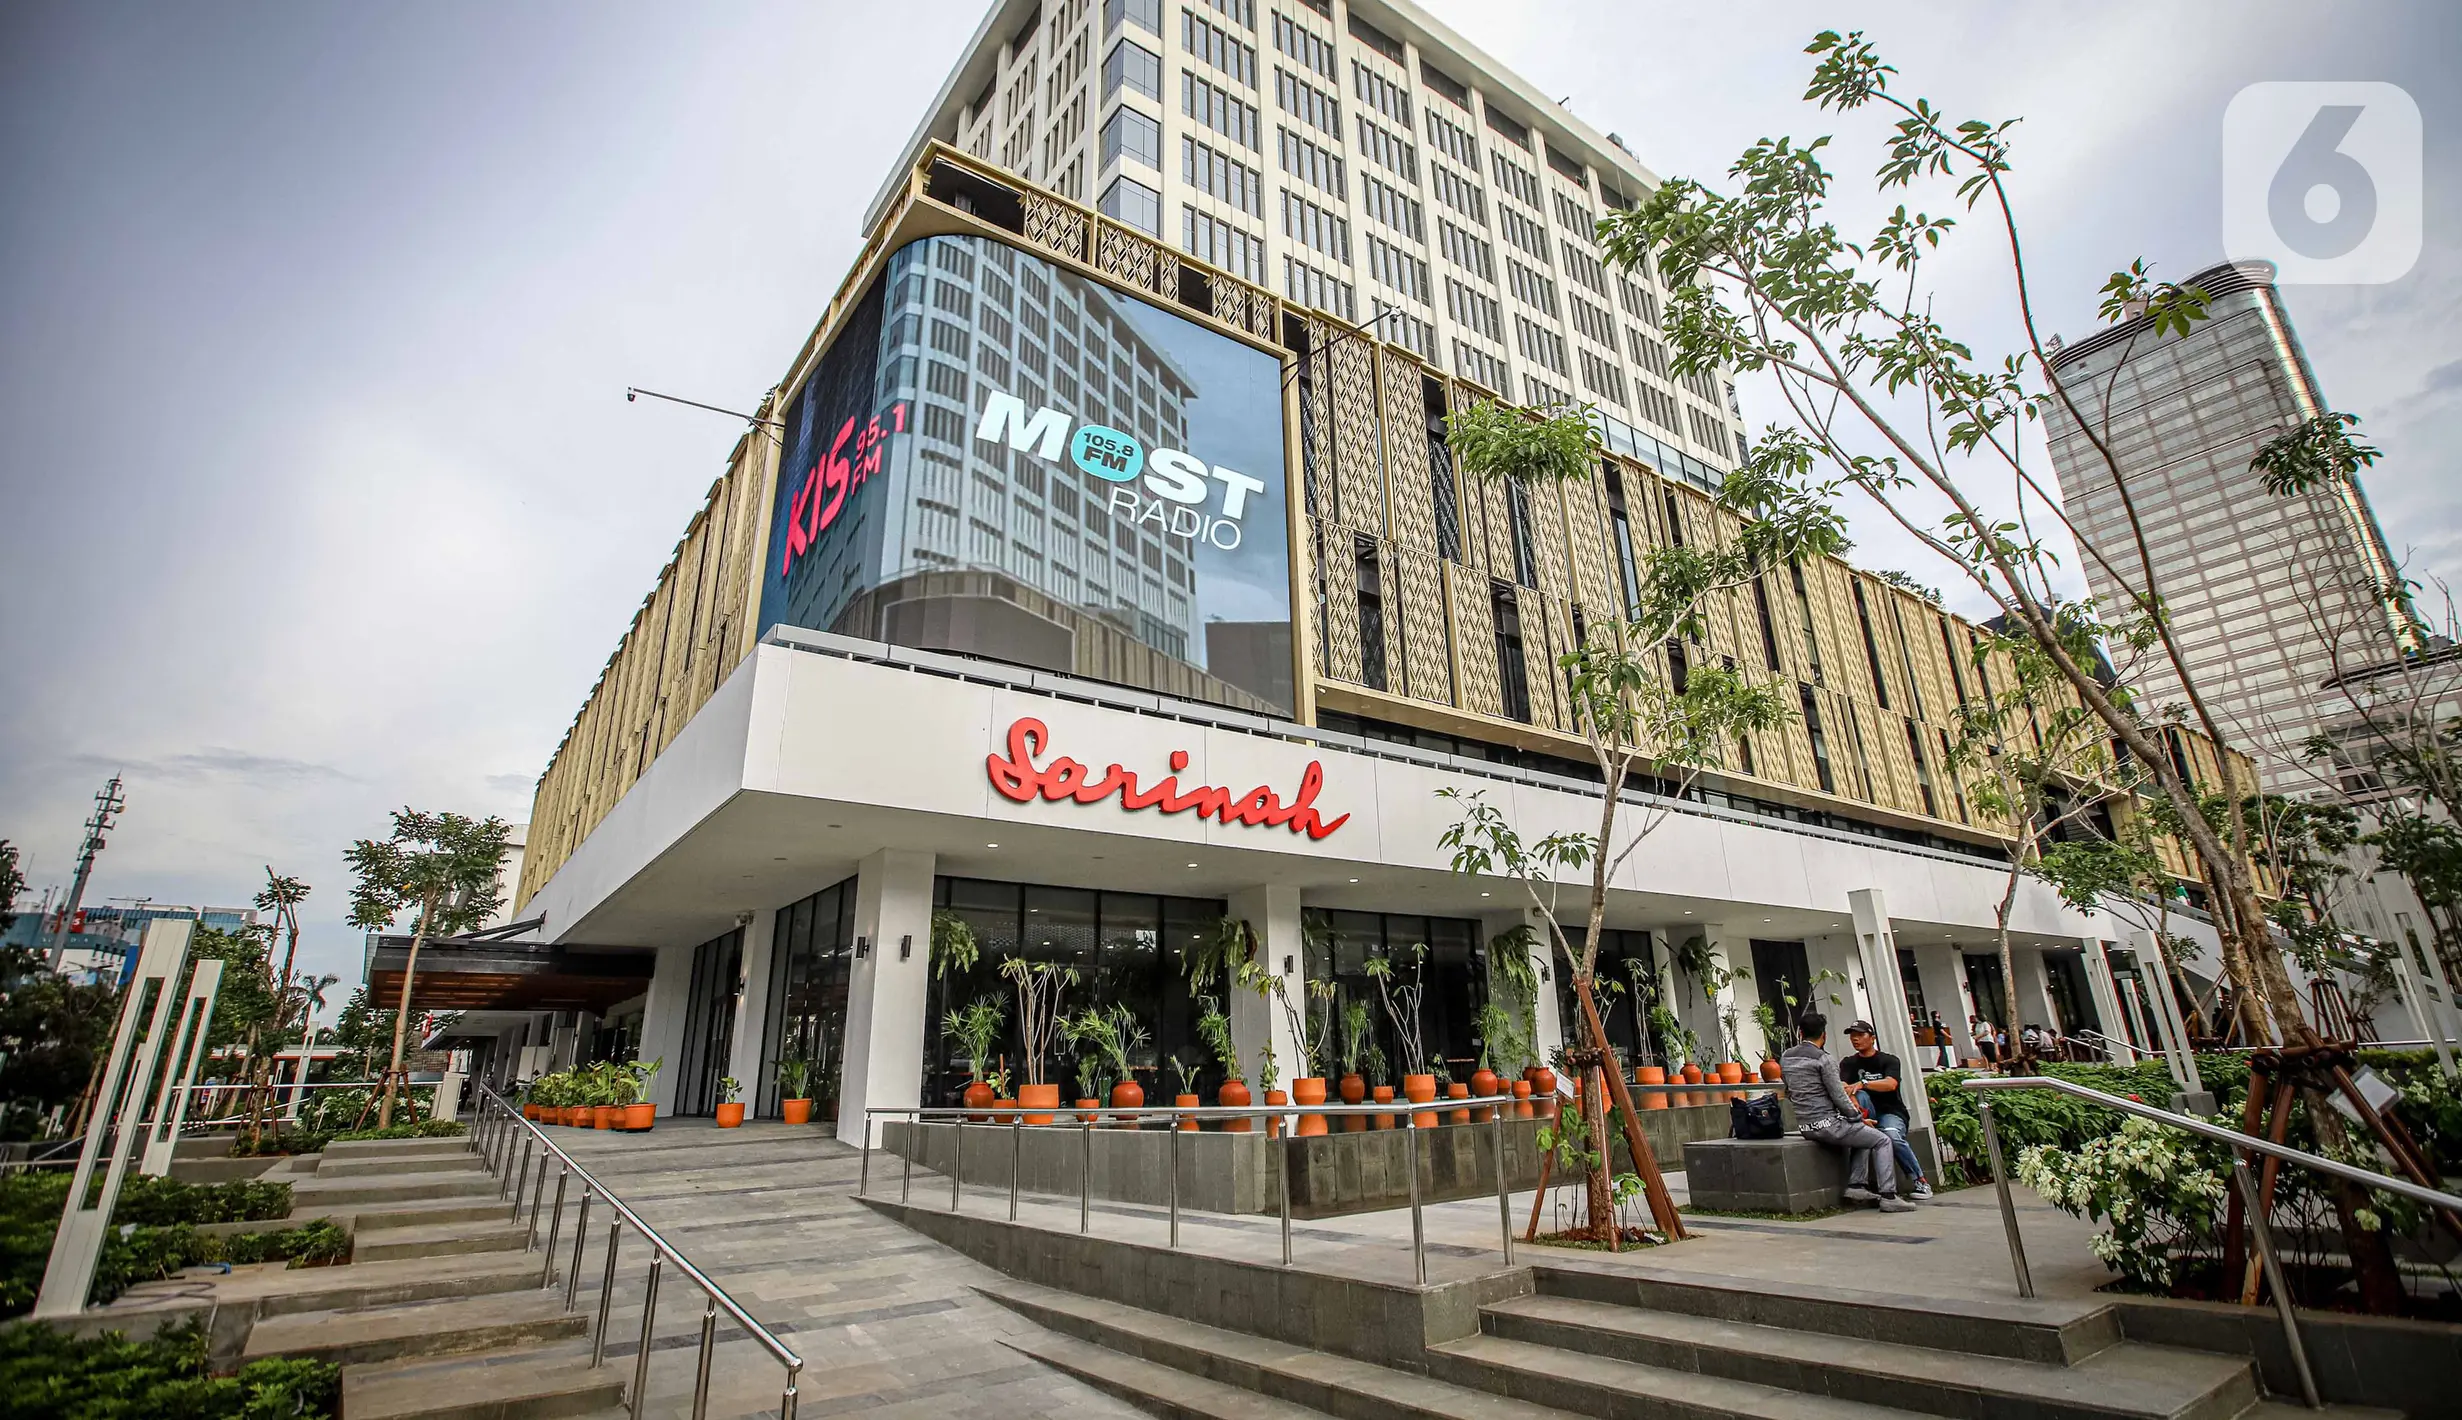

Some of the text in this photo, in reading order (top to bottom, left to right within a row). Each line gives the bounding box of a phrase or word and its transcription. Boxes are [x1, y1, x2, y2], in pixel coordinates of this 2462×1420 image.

[855, 403, 906, 461] 95.1
[1083, 432, 1135, 457] 105.8
[1083, 449, 1128, 473] FM
[782, 416, 855, 577] KIS
[851, 444, 883, 496] FM
[1107, 486, 1243, 550] RADIO
[986, 717, 1351, 840] Sarinah
